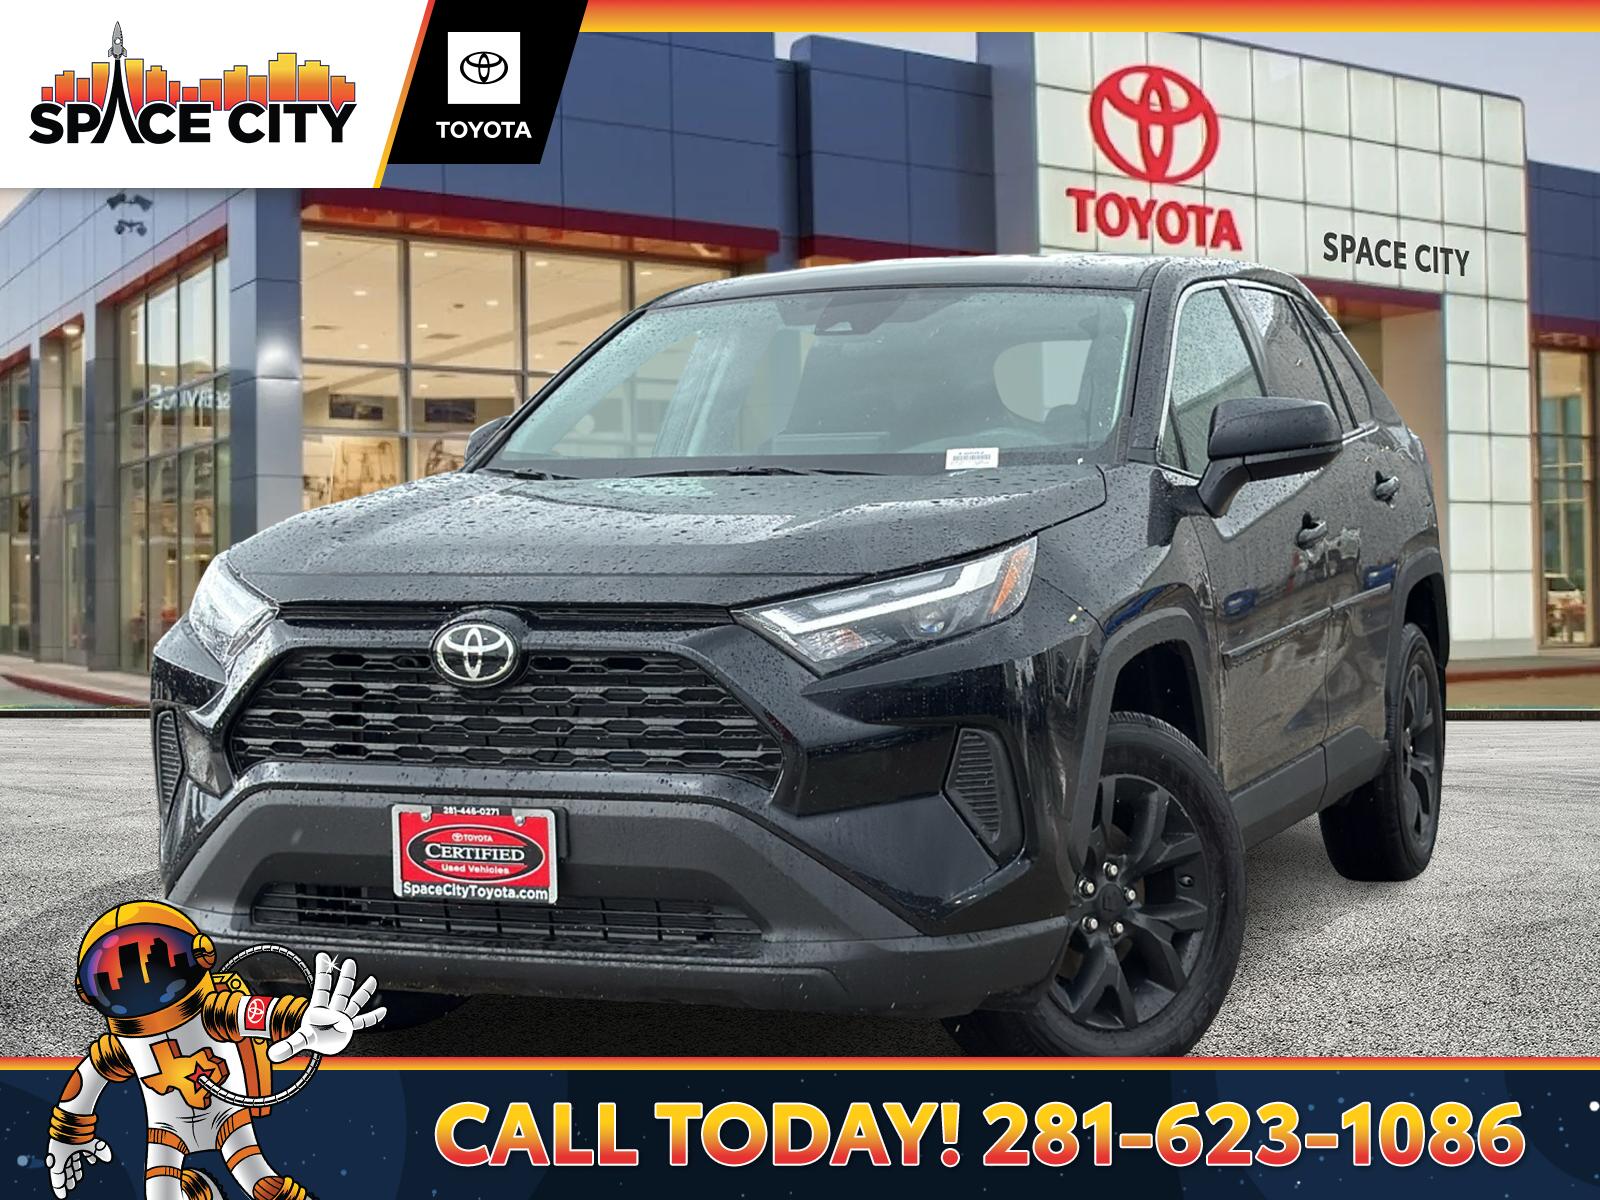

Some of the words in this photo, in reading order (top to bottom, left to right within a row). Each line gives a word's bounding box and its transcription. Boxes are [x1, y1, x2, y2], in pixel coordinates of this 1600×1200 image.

[1066, 187, 1243, 252] TOYOTA
[1323, 231, 1407, 270] SPACE
[1414, 244, 1470, 277] CITY
[464, 834, 494, 842] TOYOTA
[425, 843, 525, 862] CERTIFIED
[441, 863, 467, 873] Used
[469, 865, 510, 874] Vehicles
[403, 881, 548, 900] SpaceCityToyota.com
